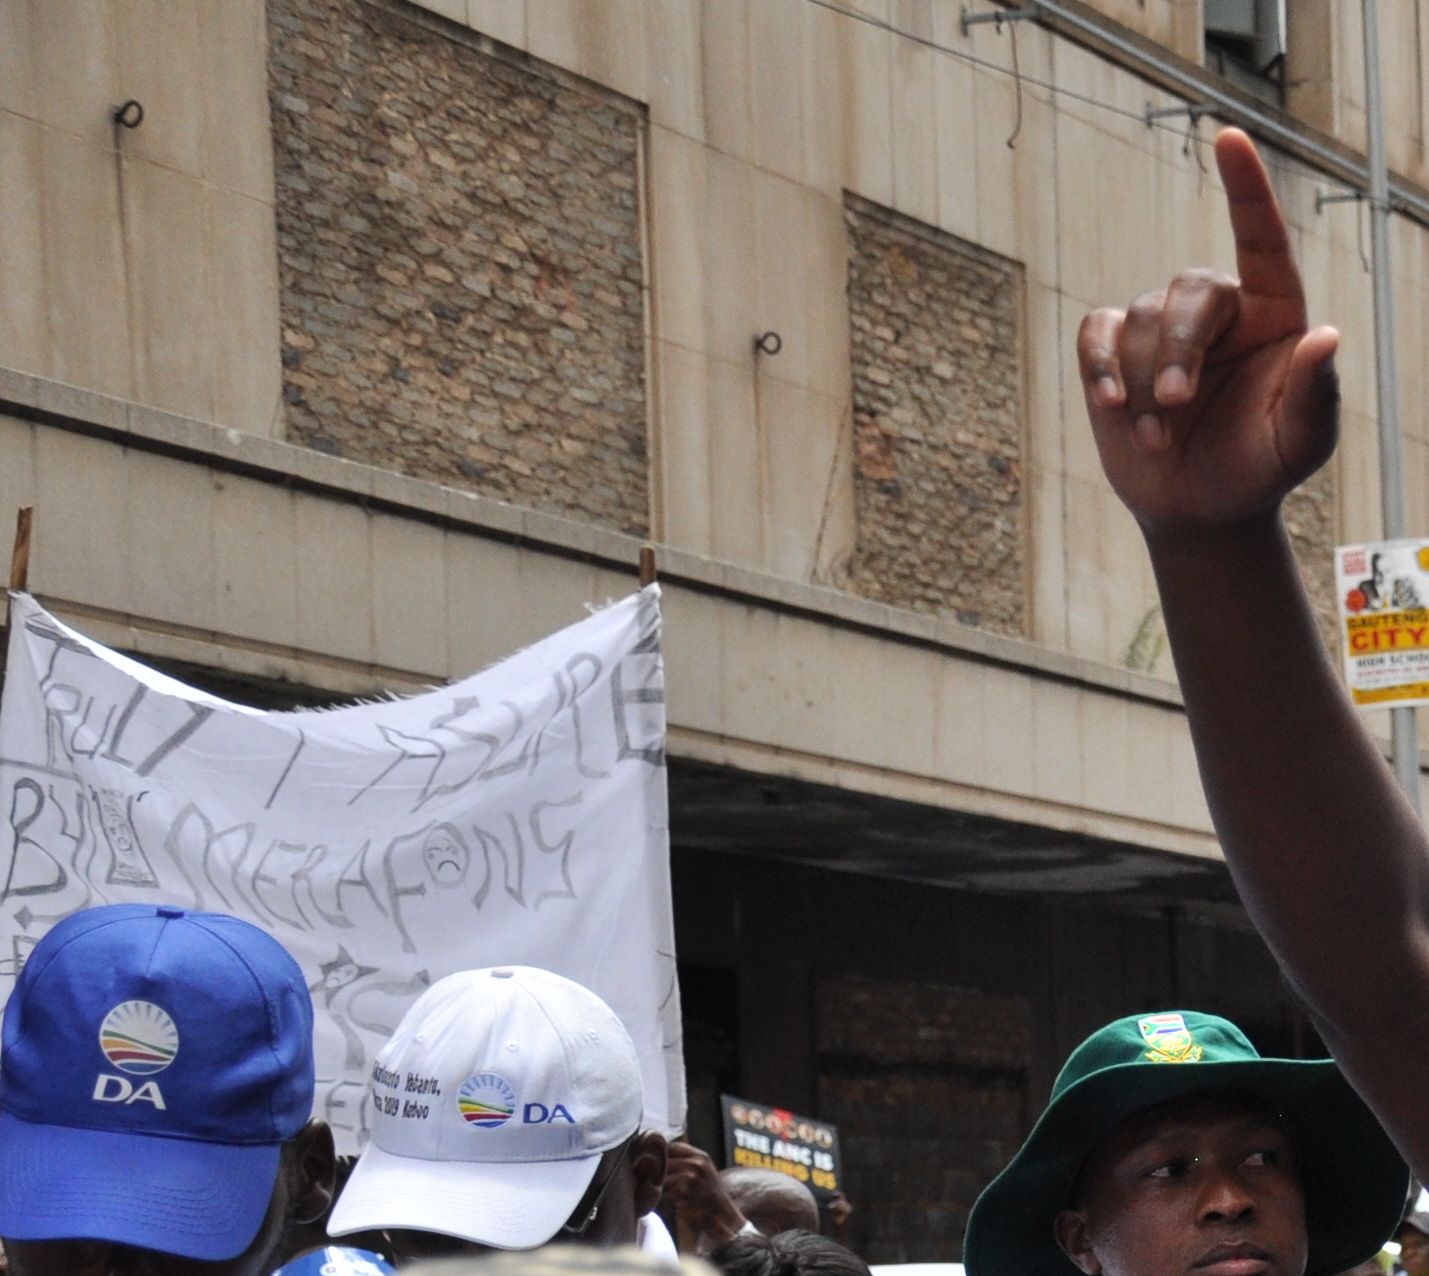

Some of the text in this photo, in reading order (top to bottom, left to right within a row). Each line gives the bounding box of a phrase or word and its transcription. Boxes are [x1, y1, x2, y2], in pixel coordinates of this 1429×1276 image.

[1351, 627, 1427, 650] CITY
[92, 1073, 167, 1111] DA
[523, 1102, 576, 1124] DA
[734, 1128, 834, 1172] THE ANC IS
[812, 1168, 837, 1190] US
